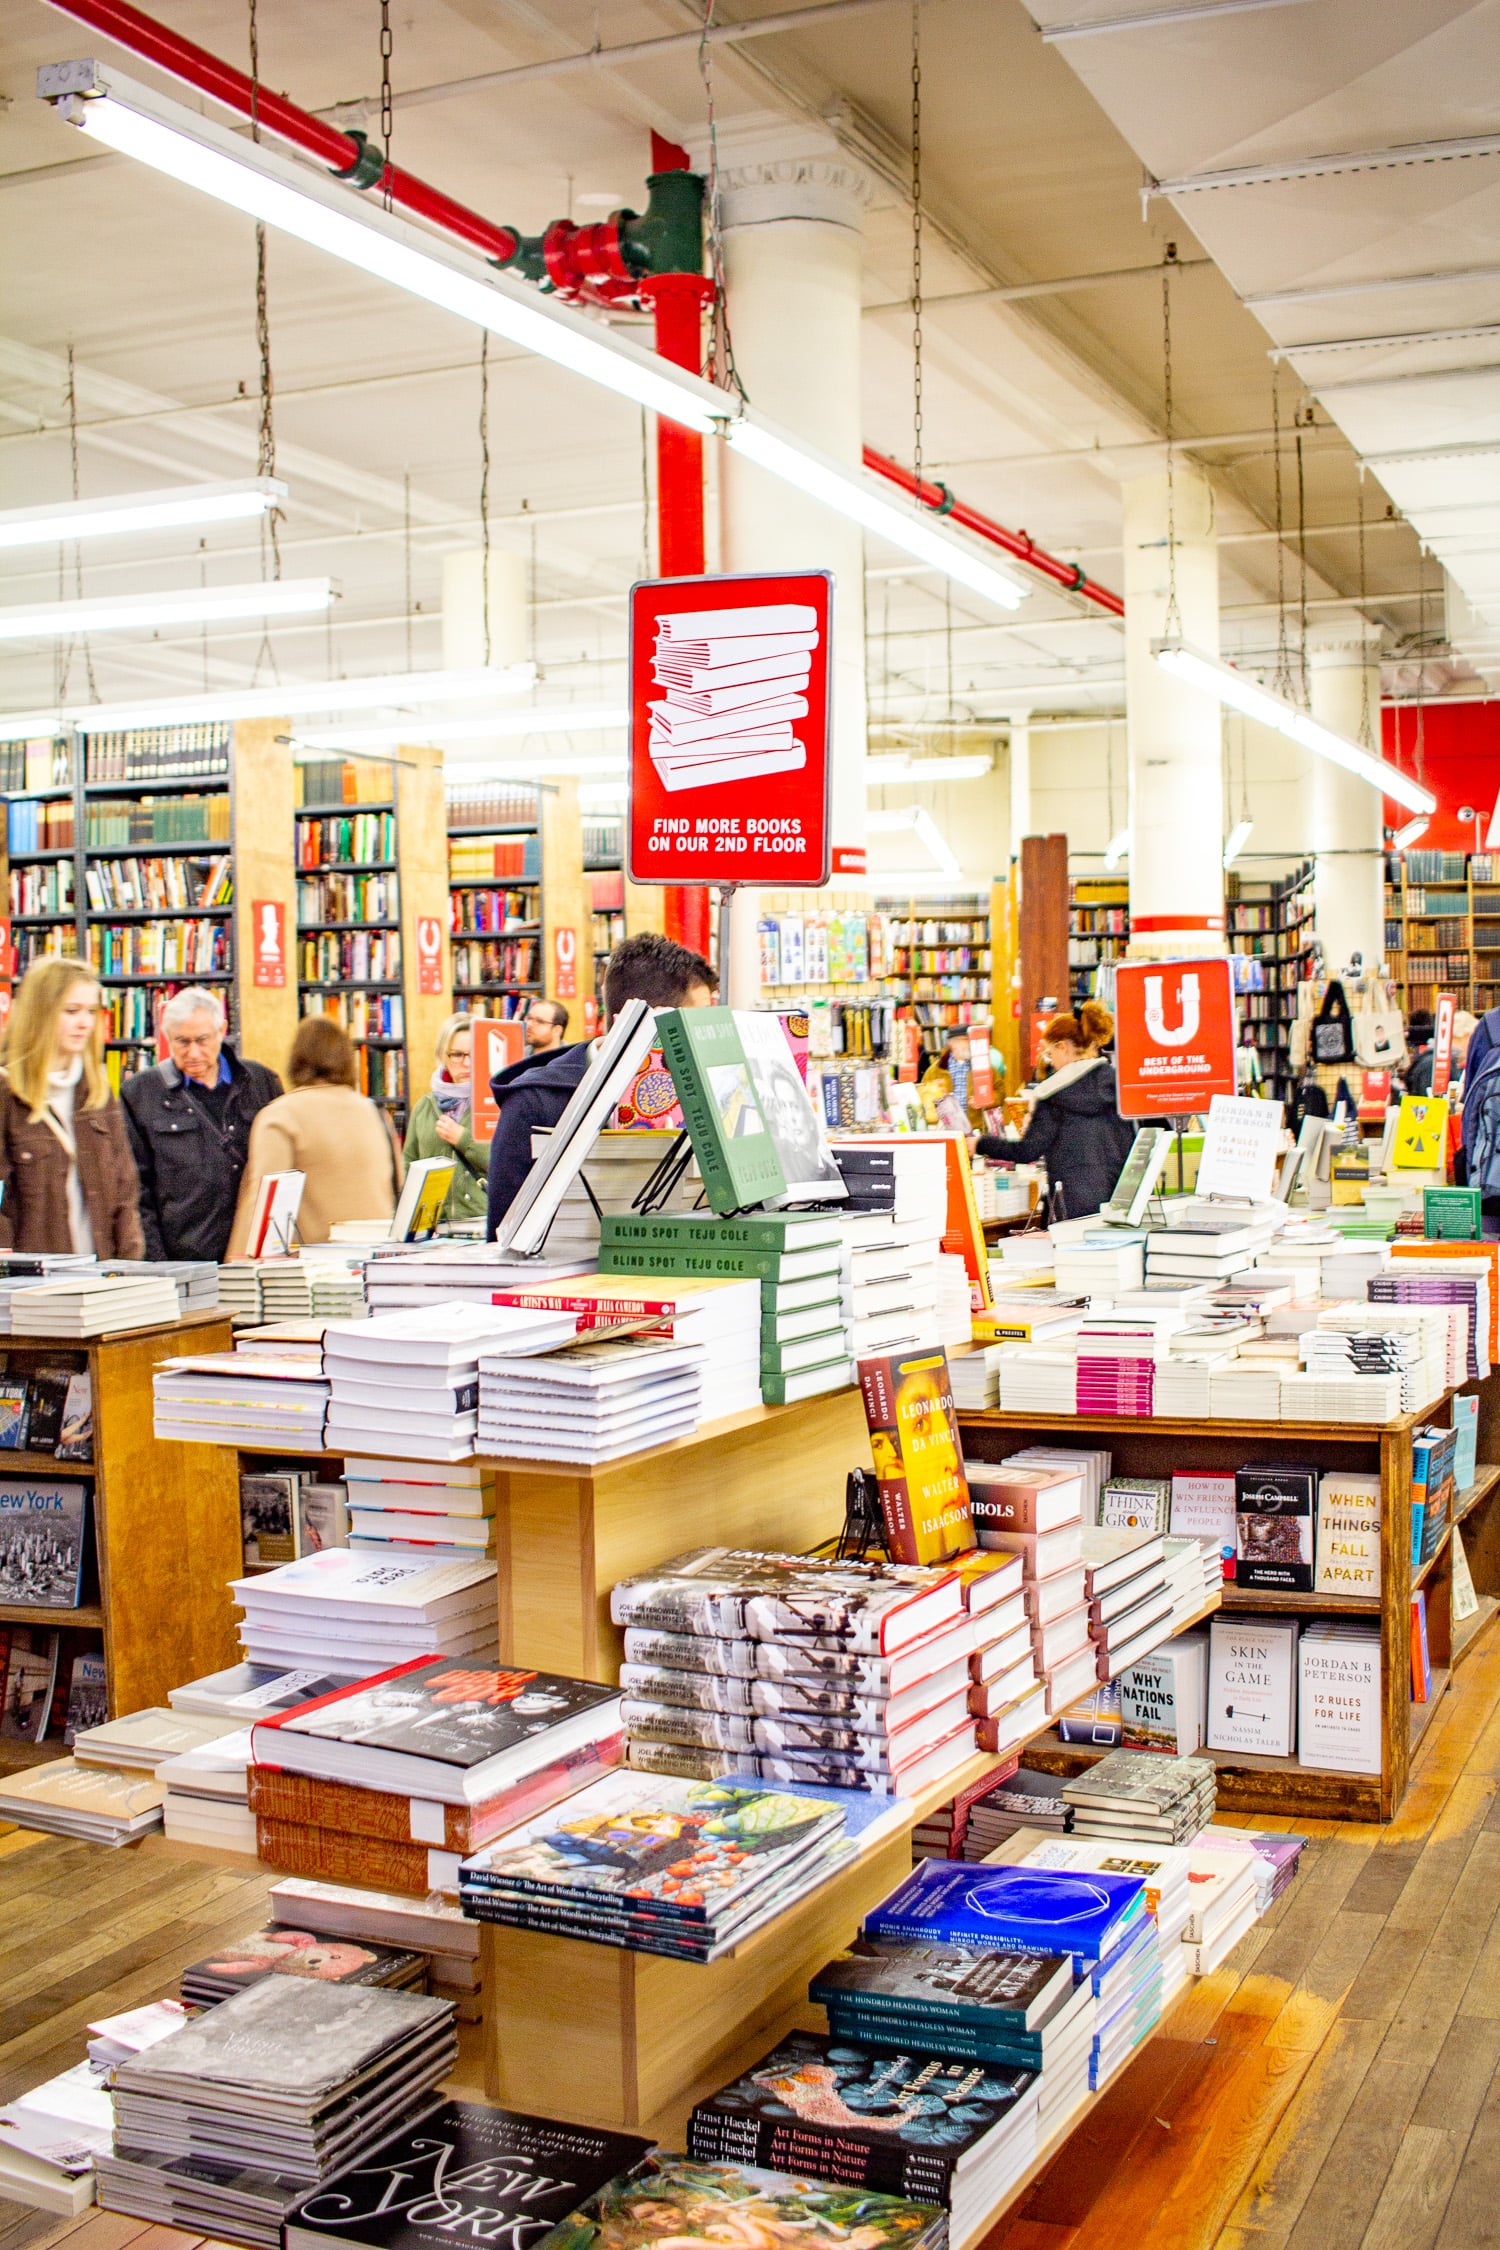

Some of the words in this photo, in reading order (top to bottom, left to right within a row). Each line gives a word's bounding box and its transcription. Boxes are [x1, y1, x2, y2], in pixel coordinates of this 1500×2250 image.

[653, 818, 690, 834] FIND
[695, 818, 741, 834] MORE
[746, 818, 802, 834] BOOKS
[648, 836, 670, 851] ON
[675, 836, 709, 852] OUR
[714, 836, 748, 852] 2ND
[753, 836, 807, 852] FLOOR
[1143, 1056, 1168, 1067] BEST
[1170, 1055, 1184, 1065] OF
[1186, 1054, 1206, 1064] THE
[1138, 1063, 1212, 1077] UNDERGROUND
[667, 1026, 687, 1064] BLIND
[679, 1066, 697, 1098] SPOT
[692, 1107, 710, 1138] TEJU
[701, 1141, 719, 1173] COLE
[615, 1226, 647, 1238] BLIND
[652, 1227, 679, 1239] SPOT
[689, 1228, 716, 1240] TEJU
[720, 1229, 749, 1241] COLE
[519, 1296, 548, 1309] ARTIST'S
[548, 1298, 562, 1309] WAY
[596, 1300, 614, 1312] JULIA
[615, 1301, 645, 1313] CAMERON
[864, 1376, 872, 1389] DA
[868, 1391, 877, 1418] VINCI
[875, 1370, 889, 1421] LEONARDO
[901, 1394, 953, 1420] LEONARDO
[911, 1437, 927, 1453] DA
[928, 1428, 955, 1447] VINCI
[922, 1475, 960, 1500] WALTER
[1188, 1481, 1209, 1490] HOW
[1213, 1482, 1225, 1490] TO
[0, 1493, 24, 1509] ew
[26, 1490, 64, 1511] York
[1107, 1495, 1155, 1511] THINK
[1175, 1493, 1194, 1501] WIN
[1196, 1494, 1236, 1503] FRIENDS
[1242, 1492, 1265, 1502] JOSEPH
[1264, 1493, 1299, 1502] CAMPBELL
[1328, 1493, 1377, 1508] WHEN
[883, 1489, 895, 1535] ISAACSON
[894, 1492, 906, 1530] WALTER
[1173, 1505, 1181, 1513] &
[1183, 1506, 1237, 1515] INFLUENCE
[922, 1506, 969, 1535] ISAACSON
[1105, 1513, 1152, 1528] GROW
[1187, 1517, 1221, 1526] PEOPLE
[1322, 1517, 1381, 1533] THINGS
[1330, 1542, 1369, 1557] FALL
[882, 1562, 947, 1574] JOEL
[1322, 1567, 1375, 1582] APART
[1231, 1645, 1267, 1659] SKIN
[1247, 1662, 1263, 1670] THE
[1304, 1657, 1359, 1671] JORDAN
[1364, 1662, 1372, 1672] B
[1132, 1672, 1162, 1689] WHY
[1225, 1671, 1272, 1686] GAME
[1304, 1669, 1372, 1684] PETERSON
[1123, 1686, 1174, 1706] NATIONS
[1314, 1694, 1325, 1704] 12
[1328, 1696, 1361, 1707] RULES
[1135, 1704, 1162, 1720] FAIL
[1314, 1708, 1334, 1719] FOR
[1339, 1711, 1361, 1722] LIFE
[645, 1717, 688, 1728] MEYEROWITZ
[1232, 1726, 1261, 1735] NASSIM
[1214, 1734, 1253, 1745] NICHOLAS
[1256, 1738, 1280, 1747] TALEB
[470, 1871, 489, 1882] David
[489, 1875, 514, 1887] Wiesner
[524, 1879, 535, 1889] The
[536, 1881, 548, 1891] Art
[549, 1884, 557, 1893] of
[557, 1885, 585, 1898] Wordless
[585, 1889, 624, 1907] Storytelling
[950, 1931, 979, 1939] INFINITE
[980, 1933, 1024, 1944] POSSIBILITY:
[950, 1937, 975, 1945] MIRROR
[977, 1940, 1001, 1948] WORKS
[1003, 1942, 1016, 1950] AND
[1018, 1944, 1052, 1953] DRAWINGS
[839, 1994, 853, 2002] THE
[855, 1996, 891, 2008] HUNDRED
[892, 2001, 928, 2012] HEADLESS
[929, 2005, 960, 2017] WOMAN
[857, 2013, 871, 2021] THE
[872, 2014, 908, 2026] HUNDRED
[909, 2019, 945, 2031] HEADLESS
[946, 2024, 976, 2036] WOMAN
[902, 2060, 943, 2093] Forms
[941, 2064, 964, 2078] in
[942, 2067, 985, 2103] Nature
[697, 2109, 721, 2124] Ernst
[724, 2115, 761, 2132] Haeckel
[460, 2112, 530, 2133] HIGHBROW
[539, 2129, 607, 2147] LOWBROW
[693, 2122, 719, 2137] Ernst
[721, 2128, 757, 2145] Haeckel
[444, 2118, 514, 2139] BRILLIANT
[521, 2135, 604, 2158] DESPICABLE
[497, 2138, 539, 2154] YEARS
[773, 2126, 790, 2138] Art
[792, 2130, 822, 2144] Forms
[824, 2134, 834, 2146] in
[836, 2137, 870, 2155] Nature
[770, 2138, 786, 2151] Art
[789, 2142, 819, 2157] Forms
[820, 2148, 831, 2158] in
[832, 2150, 867, 2167] Nature
[917, 2156, 945, 2167] PRESTEL
[352, 2138, 577, 2214] NEW
[913, 2168, 941, 2180] PRESTEL
